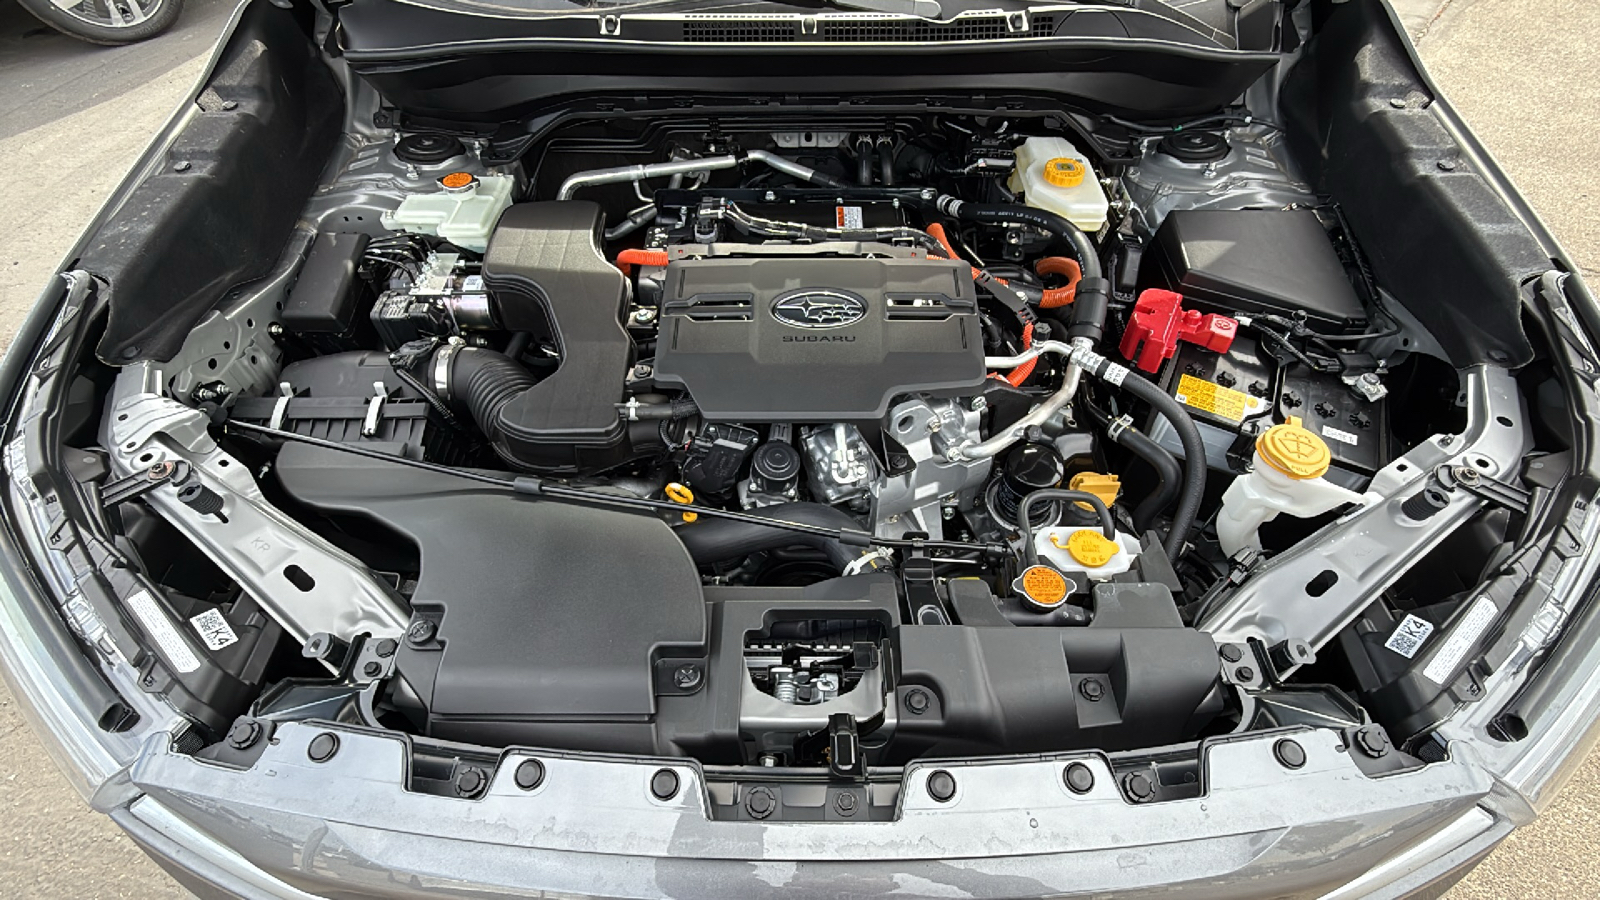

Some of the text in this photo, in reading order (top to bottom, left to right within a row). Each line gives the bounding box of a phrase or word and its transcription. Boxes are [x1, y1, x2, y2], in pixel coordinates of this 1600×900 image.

[782, 335, 856, 343] SUBARU
[210, 627, 229, 646] K4
[1404, 619, 1426, 638] K4
